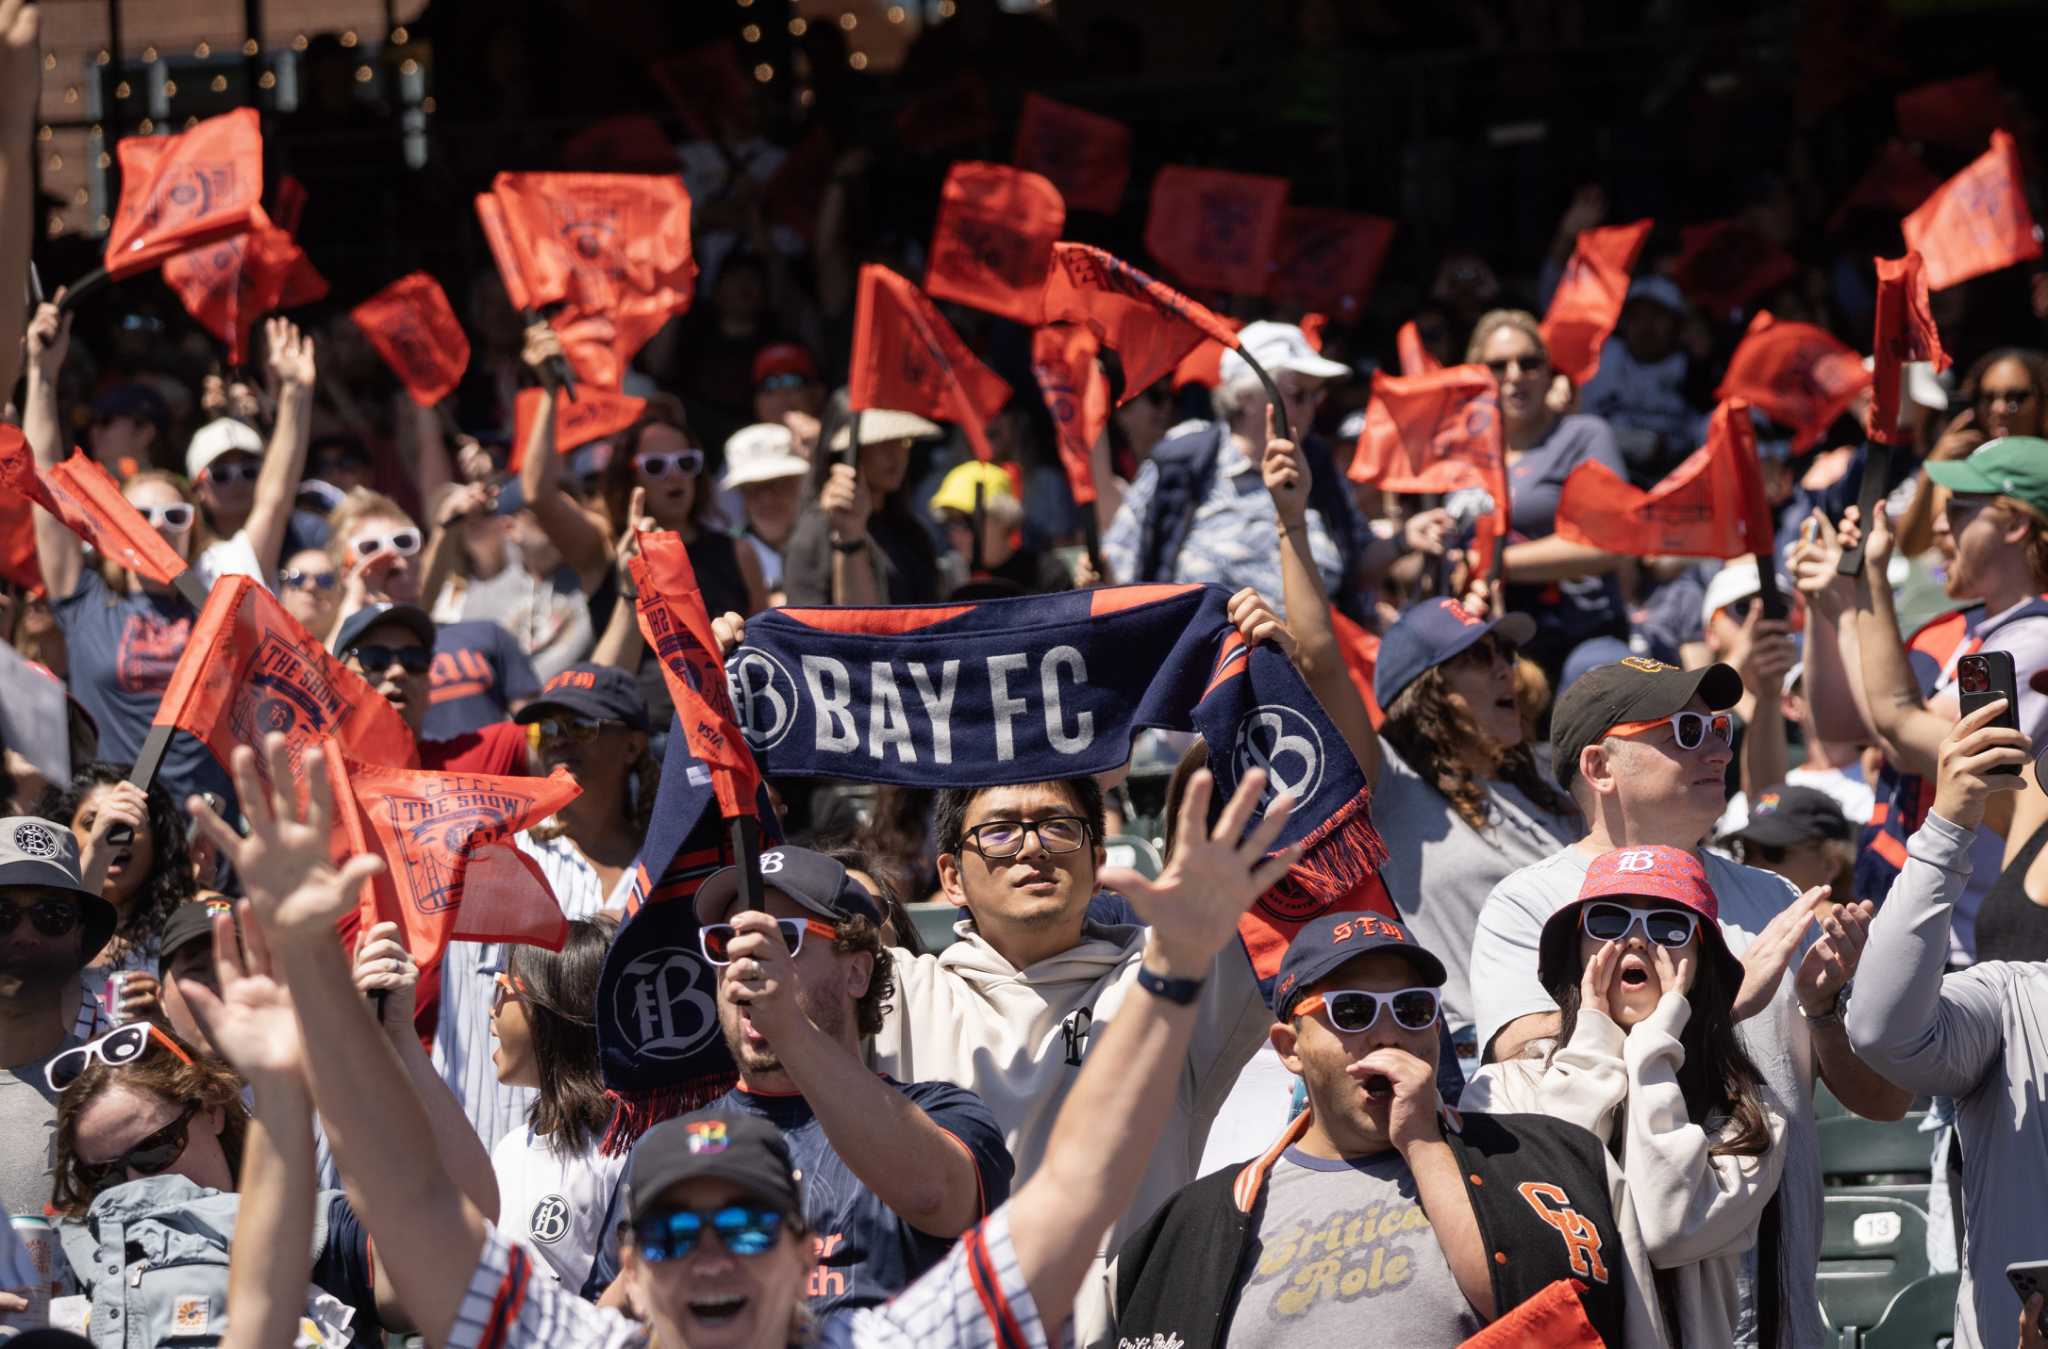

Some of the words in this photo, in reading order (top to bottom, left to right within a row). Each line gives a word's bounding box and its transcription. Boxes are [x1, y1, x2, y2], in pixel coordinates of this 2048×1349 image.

[262, 644, 301, 678] THE
[801, 654, 960, 764] BAY
[987, 645, 1095, 762] FC
[697, 720, 725, 750] VISA
[403, 797, 449, 822] THE
[457, 794, 519, 820] SHOW
[1254, 1202, 1432, 1278] Critica
[1518, 1182, 1608, 1283] CR
[1867, 1218, 1889, 1236] 13
[1270, 1246, 1413, 1319] Role
